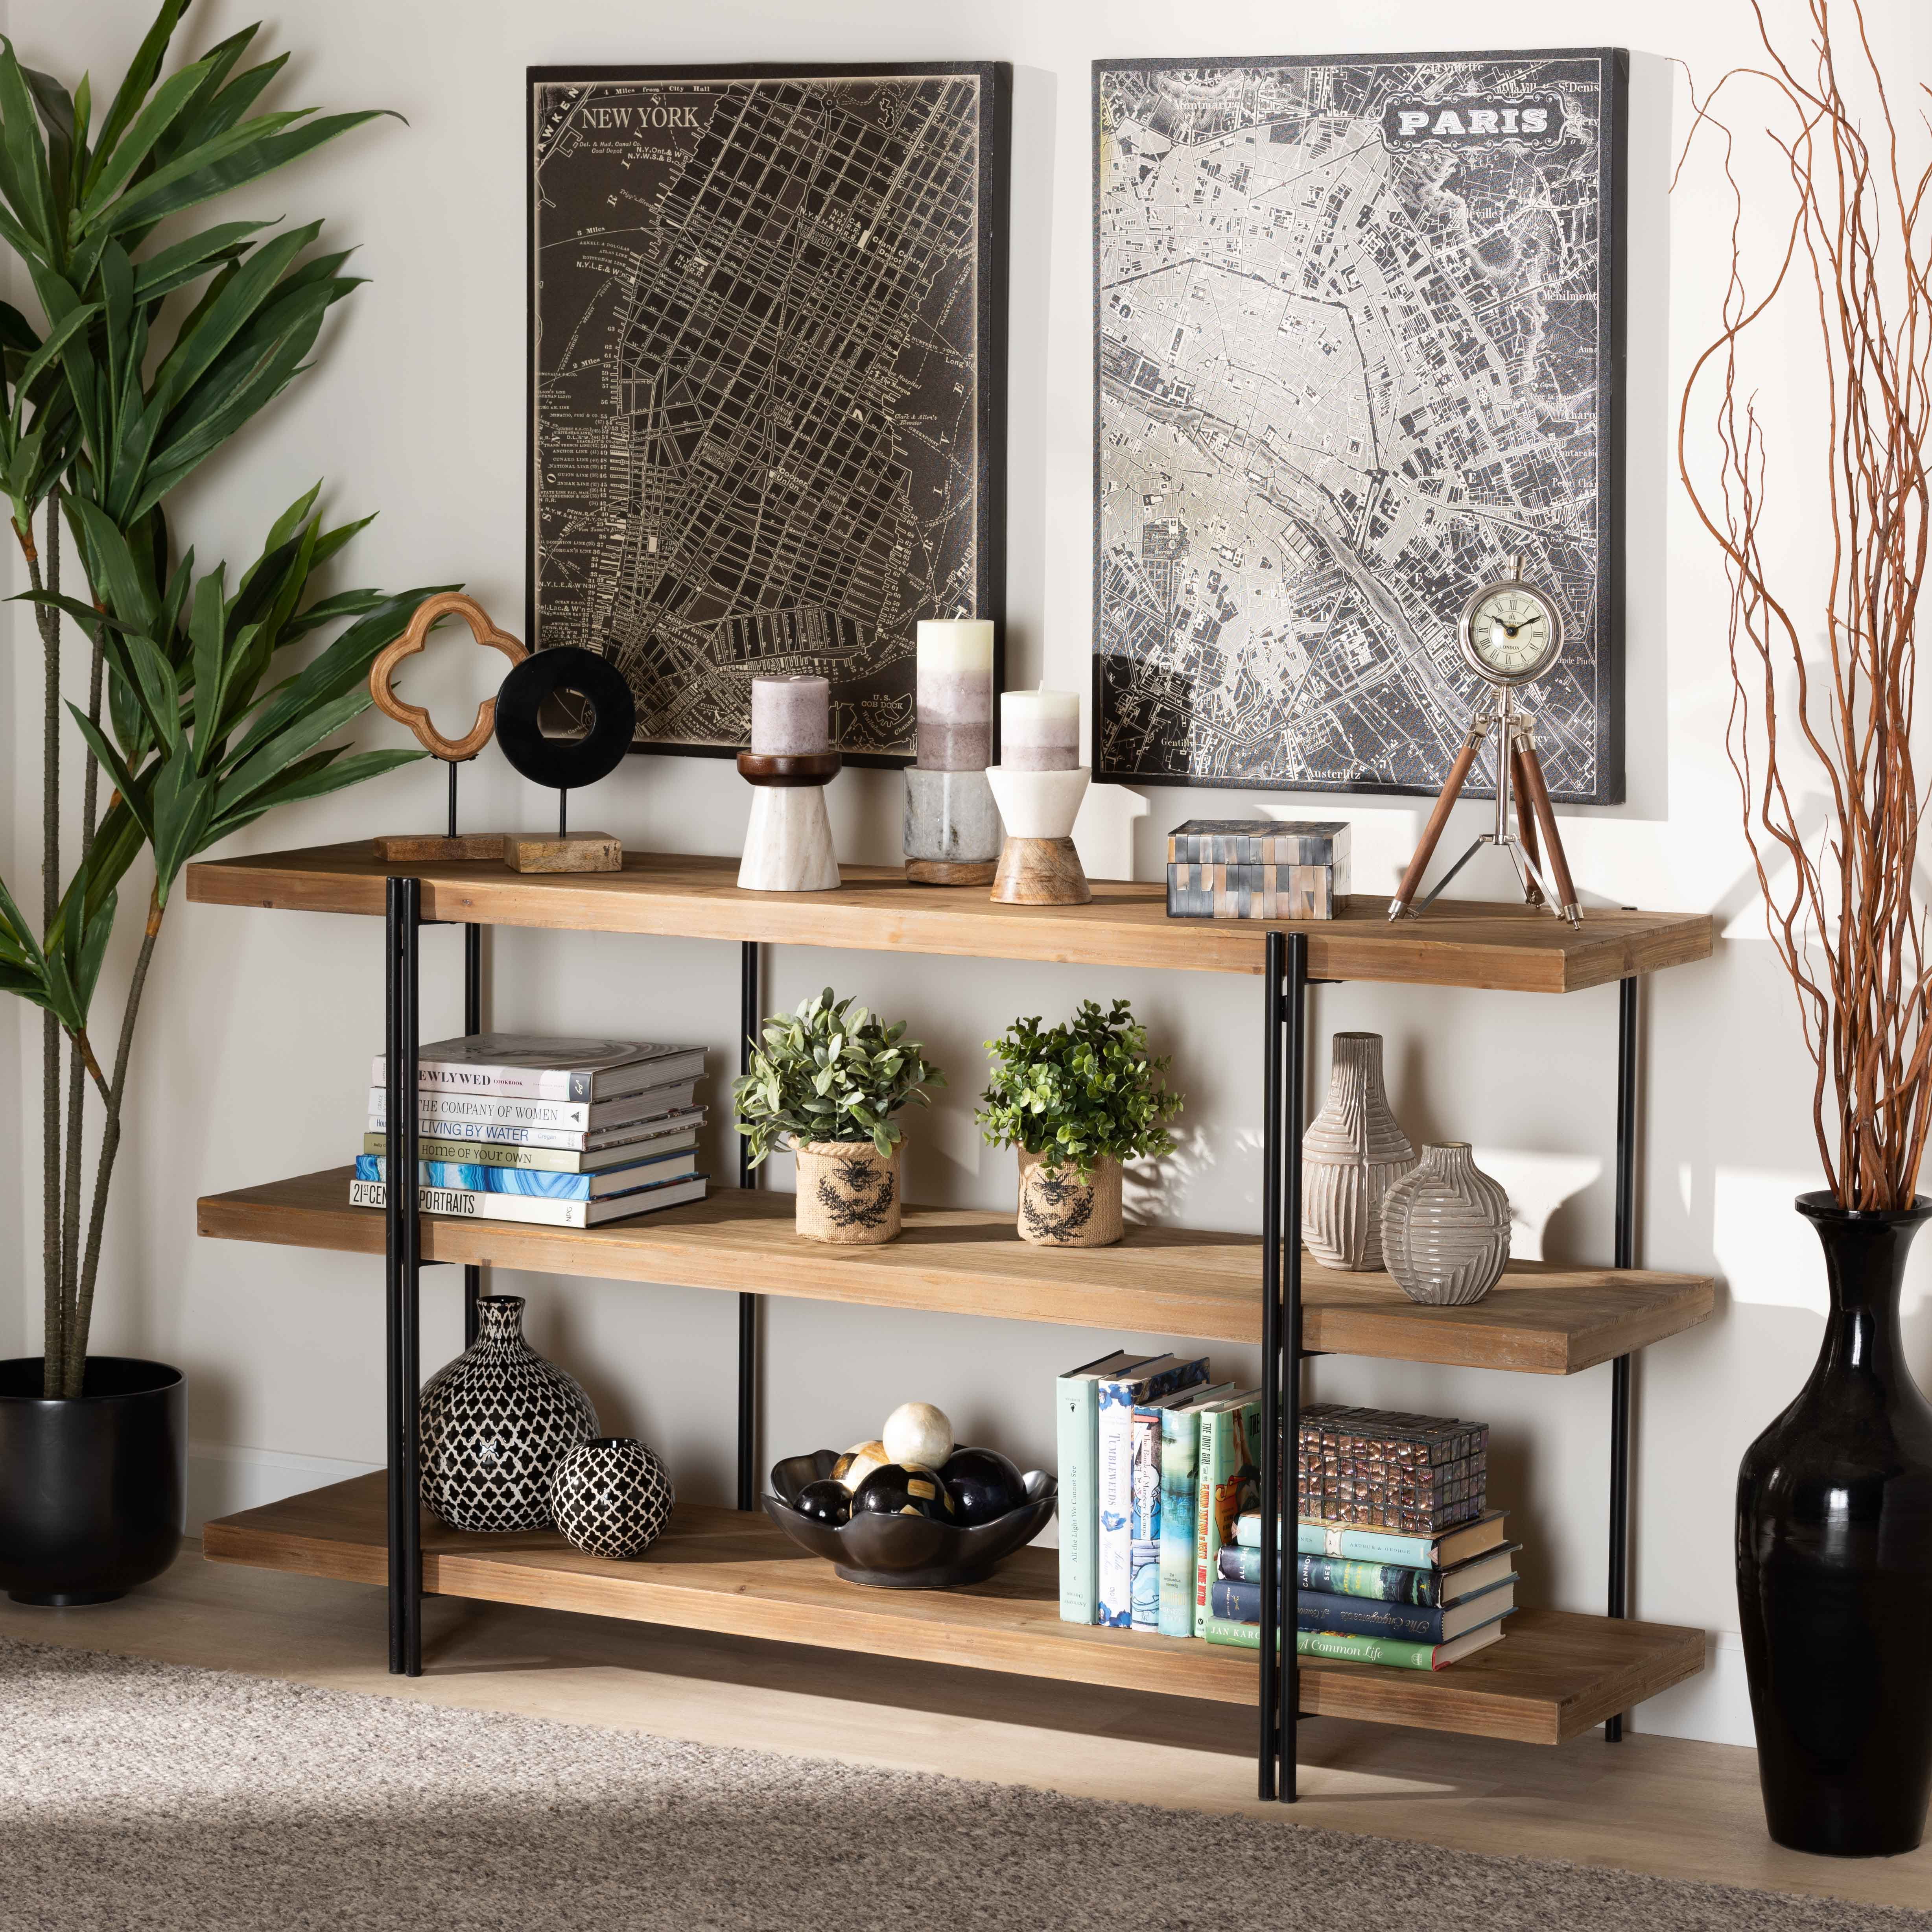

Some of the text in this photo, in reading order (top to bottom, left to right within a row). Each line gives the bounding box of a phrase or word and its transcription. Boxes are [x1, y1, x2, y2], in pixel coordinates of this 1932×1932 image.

[1569, 82, 1599, 93] Denis
[582, 107, 699, 128] NEW YORK
[933, 100, 949, 124] HAVEN
[1398, 108, 1547, 135] PARIS
[902, 122, 924, 155] CENTRAL
[582, 255, 612, 264] ROTTERDAM
[872, 236, 924, 269] Grand Centra
[878, 248, 903, 265] Depot
[581, 358, 601, 367] Miles
[946, 358, 964, 368] Long
[890, 380, 911, 396] Morgue
[898, 374, 922, 390] Hospital
[777, 475, 800, 491] Union
[779, 468, 808, 487] Cooper
[1469, 473, 1477, 483] E
[1415, 573, 1423, 583] E
[1495, 602, 1504, 613] XI
[1509, 599, 1517, 610] XII
[1320, 611, 1329, 622] D
[894, 715, 916, 736] Channel
[418, 1070, 491, 1086] EWLYWED
[441, 1101, 495, 1117] COMPANY
[498, 1105, 512, 1118] OF
[516, 1107, 559, 1121] WOMEN
[376, 1119, 386, 1128] Hou
[422, 1121, 529, 1141] LIVING BY WATER
[458, 1147, 470, 1158] OF
[505, 1152, 532, 1164] OWN
[419, 1190, 475, 1214] PORTRAITS
[1202, 1423, 1211, 1434] THE
[1202, 1434, 1211, 1451] IDIOT
[1201, 1453, 1211, 1465] GIRL
[1108, 1433, 1121, 1506] TUMBLEWEEDS
[1143, 1470, 1150, 1479] of
[1141, 1480, 1149, 1510] Margery
[1070, 1507, 1077, 1517] We
[1070, 1519, 1079, 1537] Light
[1239, 1547, 1250, 1561] THE
[1211, 1626, 1230, 1636] JAN
[1298, 1639, 1384, 1661] A Common Life
